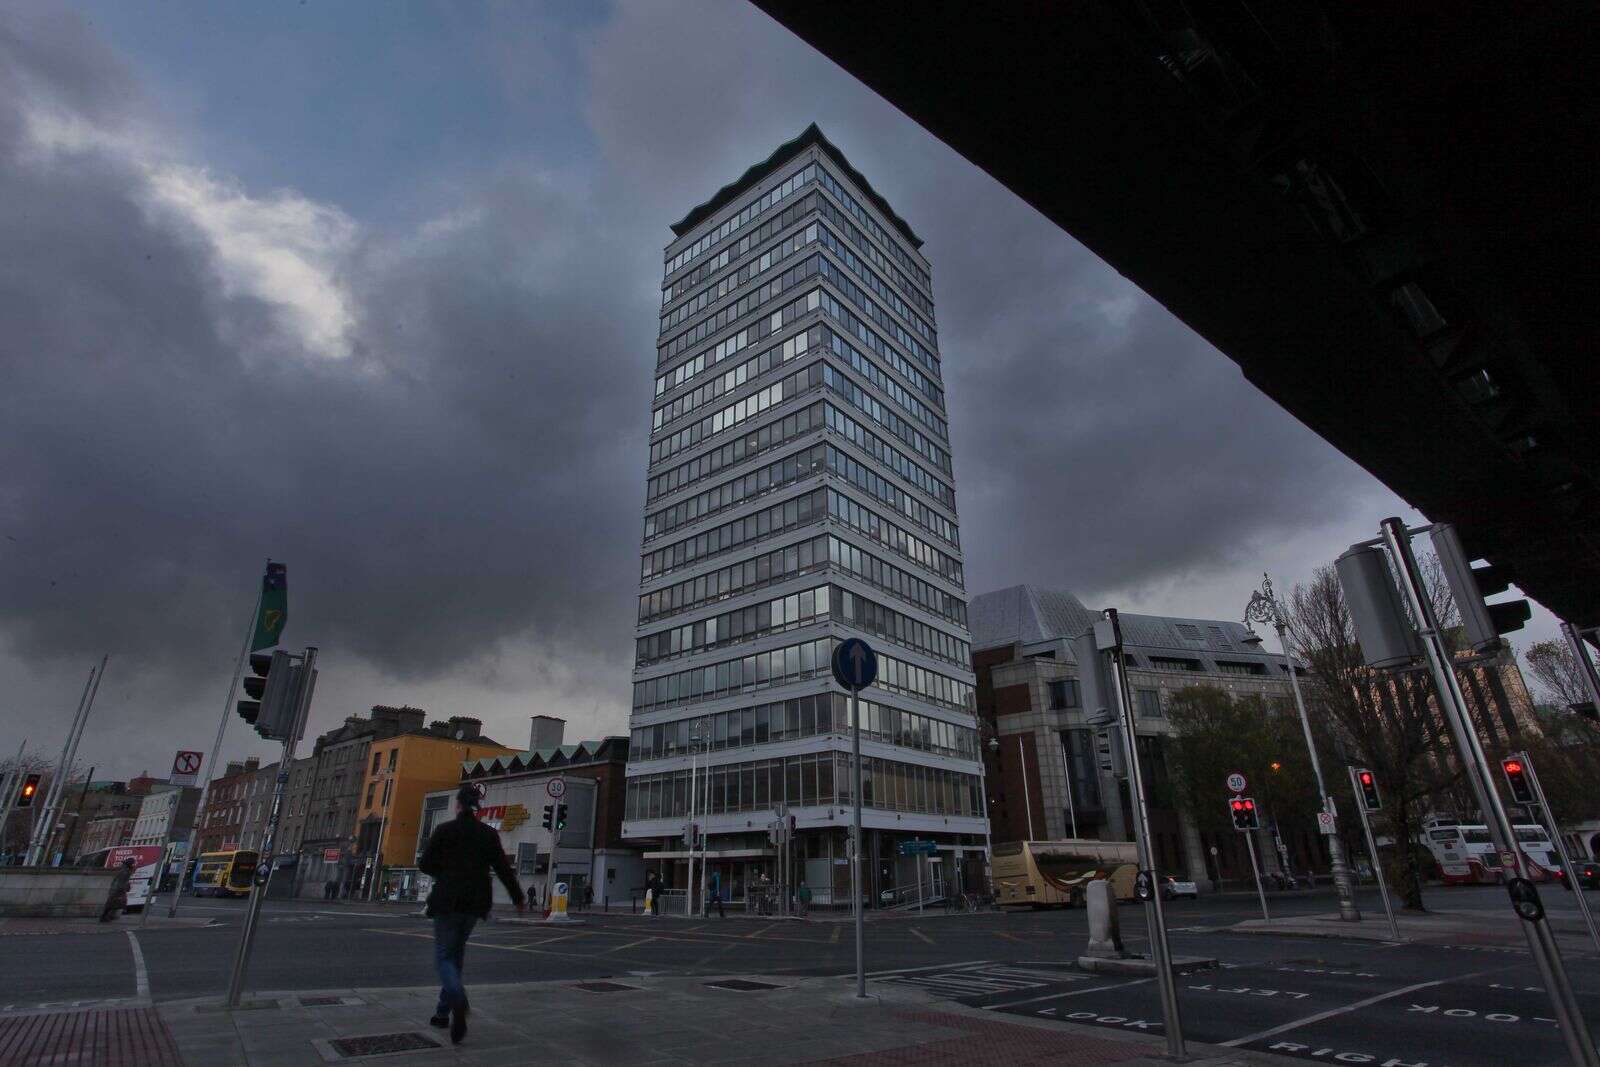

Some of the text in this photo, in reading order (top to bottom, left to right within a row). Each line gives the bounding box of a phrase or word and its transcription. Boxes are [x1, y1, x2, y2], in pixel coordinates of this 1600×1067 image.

[1230, 777, 1243, 787] 50
[1187, 984, 1311, 999] LEFT
[1037, 1007, 1164, 1028] LOOK
[1407, 1003, 1559, 1028] LOOK
[1268, 1041, 1440, 1067] RIGH
